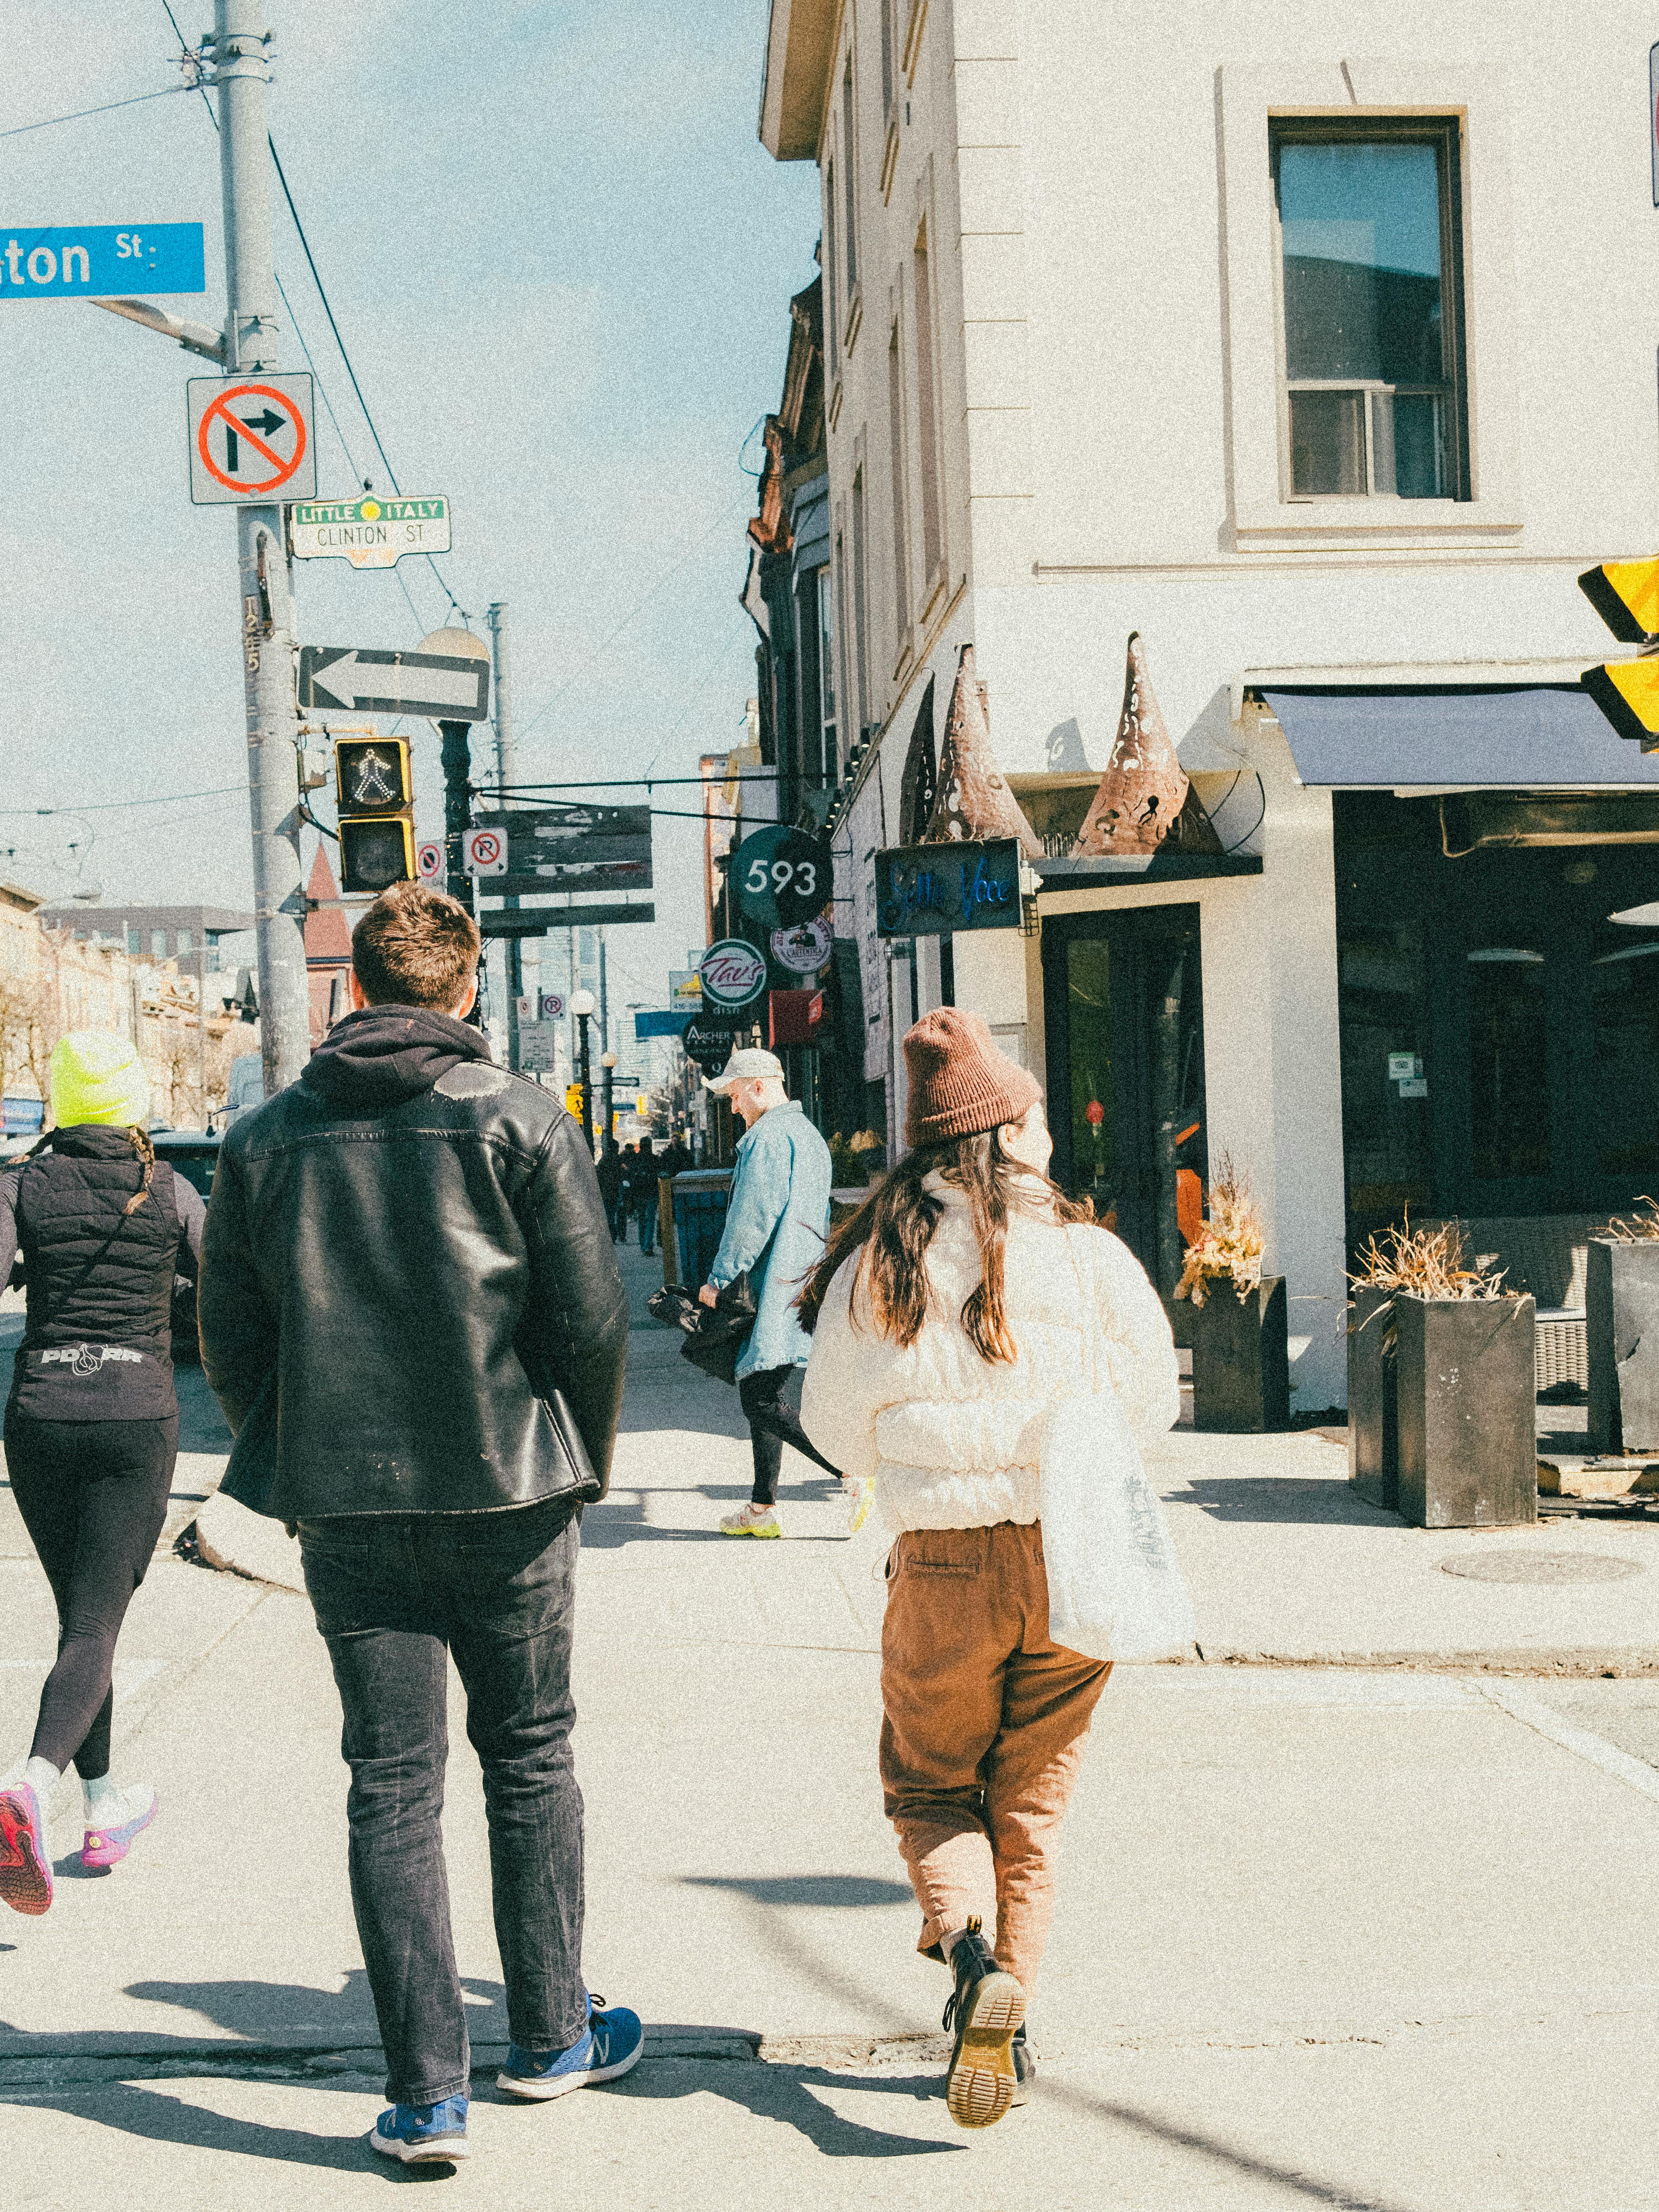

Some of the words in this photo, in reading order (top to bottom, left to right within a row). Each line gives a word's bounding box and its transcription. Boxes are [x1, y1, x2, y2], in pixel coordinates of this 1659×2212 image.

[0, 239, 90, 284] ton
[116, 233, 142, 258] St
[301, 506, 355, 523] LITTLE
[387, 502, 439, 519] ITALY
[318, 526, 387, 546] CLINTON
[406, 524, 425, 542] ST
[745, 860, 816, 895] 593
[700, 957, 765, 983] Tav's
